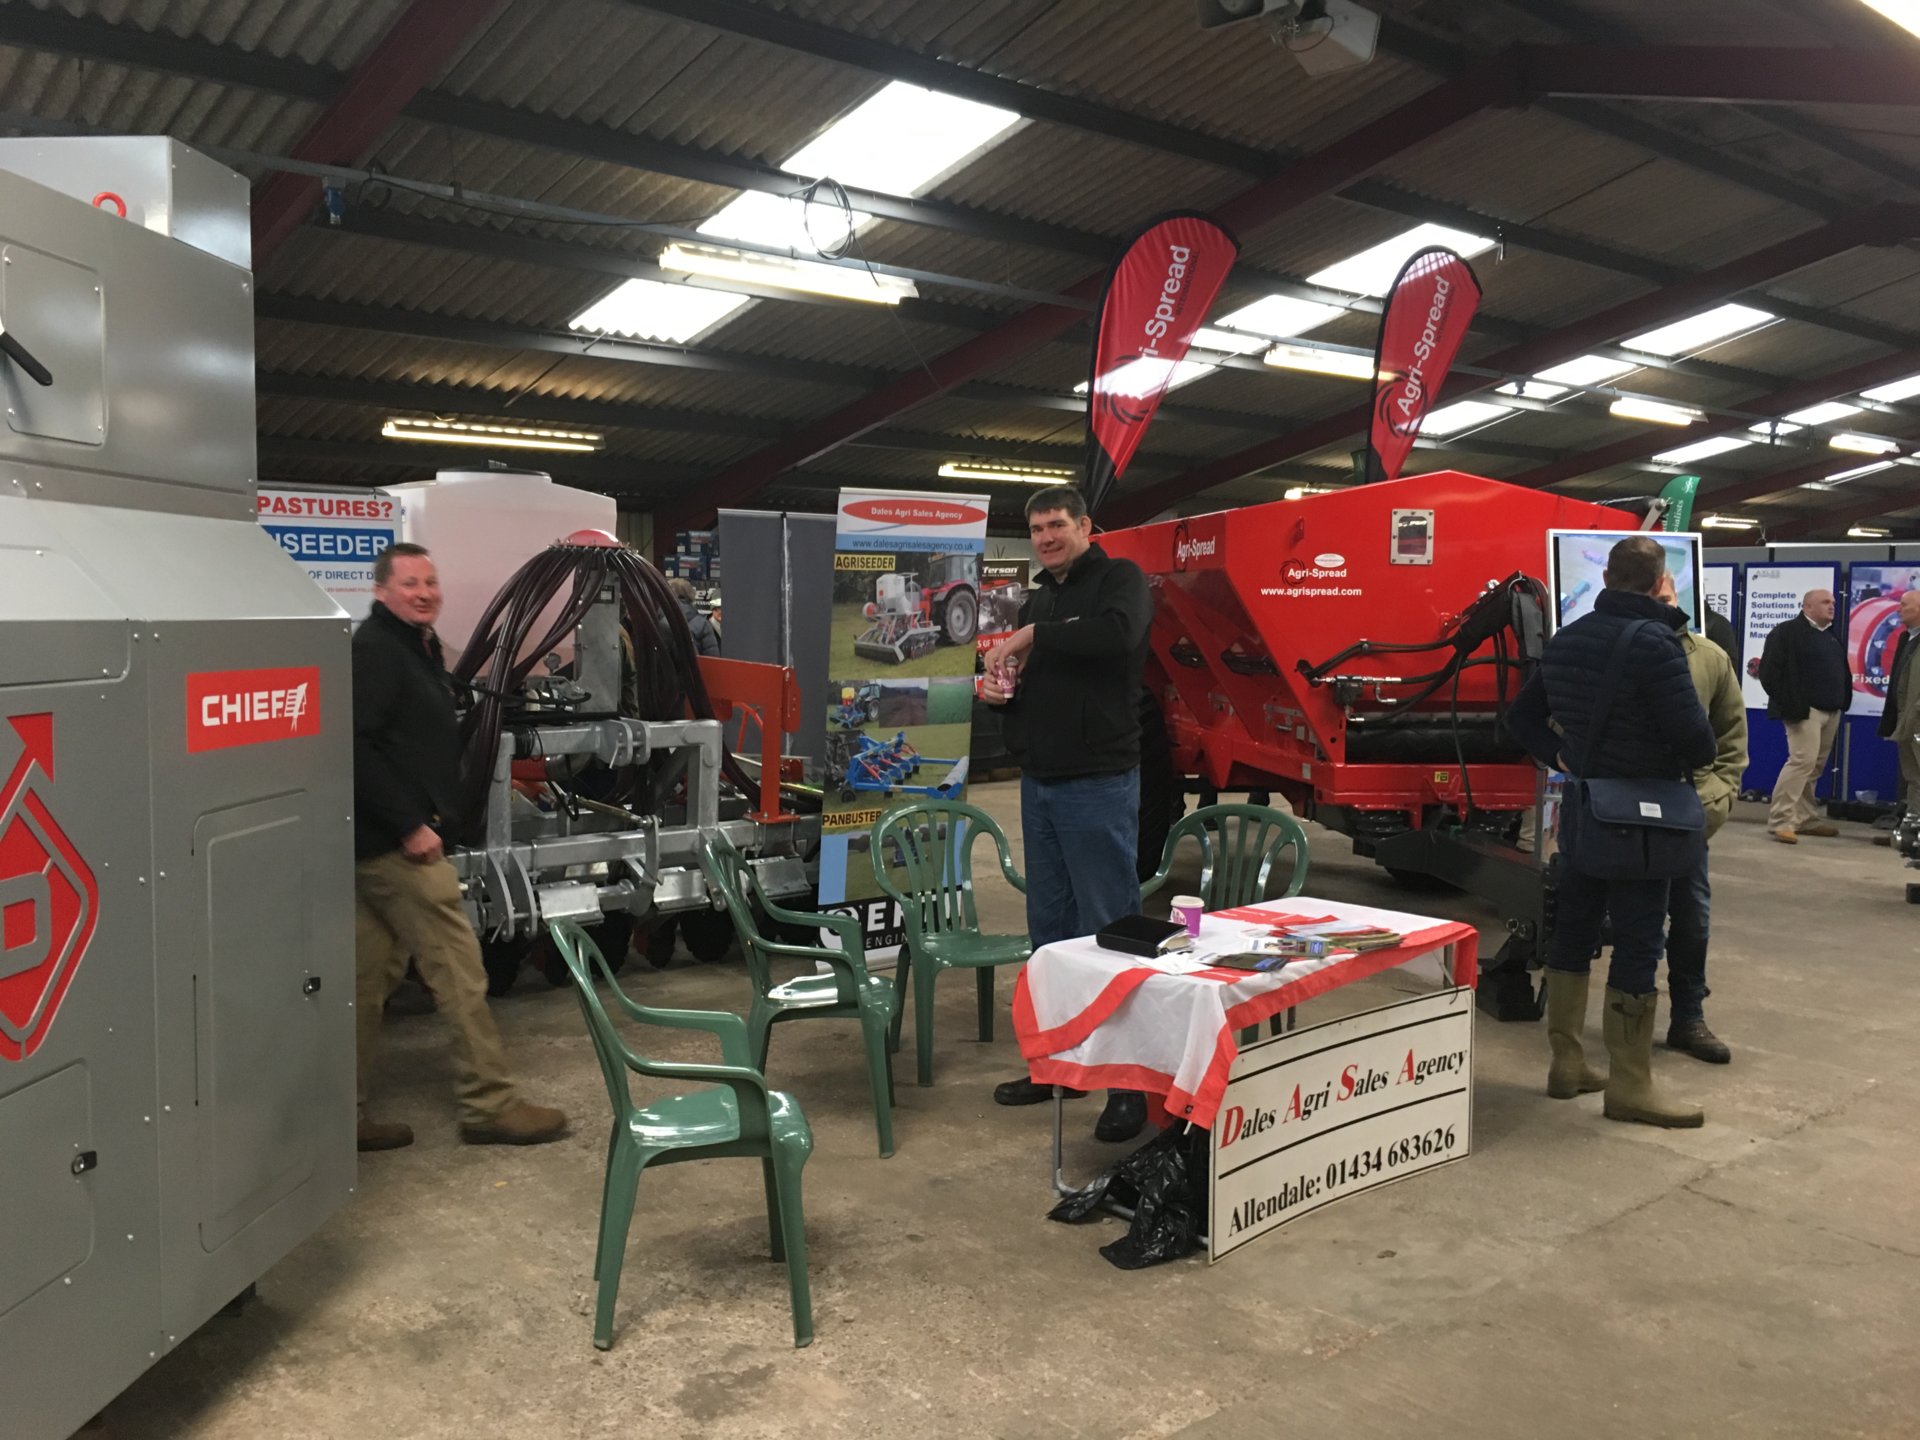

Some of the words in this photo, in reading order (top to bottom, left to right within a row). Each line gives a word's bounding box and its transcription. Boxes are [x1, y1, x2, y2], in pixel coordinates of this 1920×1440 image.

[1139, 244, 1191, 356] i-Spread
[1397, 275, 1450, 416] Agri-Spread
[257, 496, 393, 518] PASTURES?
[871, 507, 893, 516] Dales
[895, 508, 911, 518] Agri
[912, 509, 934, 518] Sales
[935, 510, 963, 520] Agency
[852, 539, 974, 551] www.dalesagrisalesagency.co.uk
[1177, 535, 1216, 562] Agri-Spread
[835, 555, 895, 569] AGRISEEDER
[325, 571, 365, 580] DIRECT
[1288, 568, 1347, 579] Agri-Spread
[1260, 587, 1362, 597] www.agrispread.com
[1751, 591, 1796, 600] Complete
[1751, 601, 1795, 609] Solutions
[1750, 611, 1798, 620] Agricultur
[1852, 674, 1890, 685] Fixed
[202, 689, 286, 727] CHIEF
[822, 811, 882, 826] PANBUSTER
[1218, 1105, 1276, 1149] Dales
[1282, 1081, 1332, 1124] Agri
[1336, 1064, 1389, 1103] Sales
[1395, 1049, 1467, 1086] Agency
[1228, 1175, 1321, 1238] Allendale:
[1325, 1146, 1382, 1189] 01434
[1387, 1124, 1455, 1167] 683626
